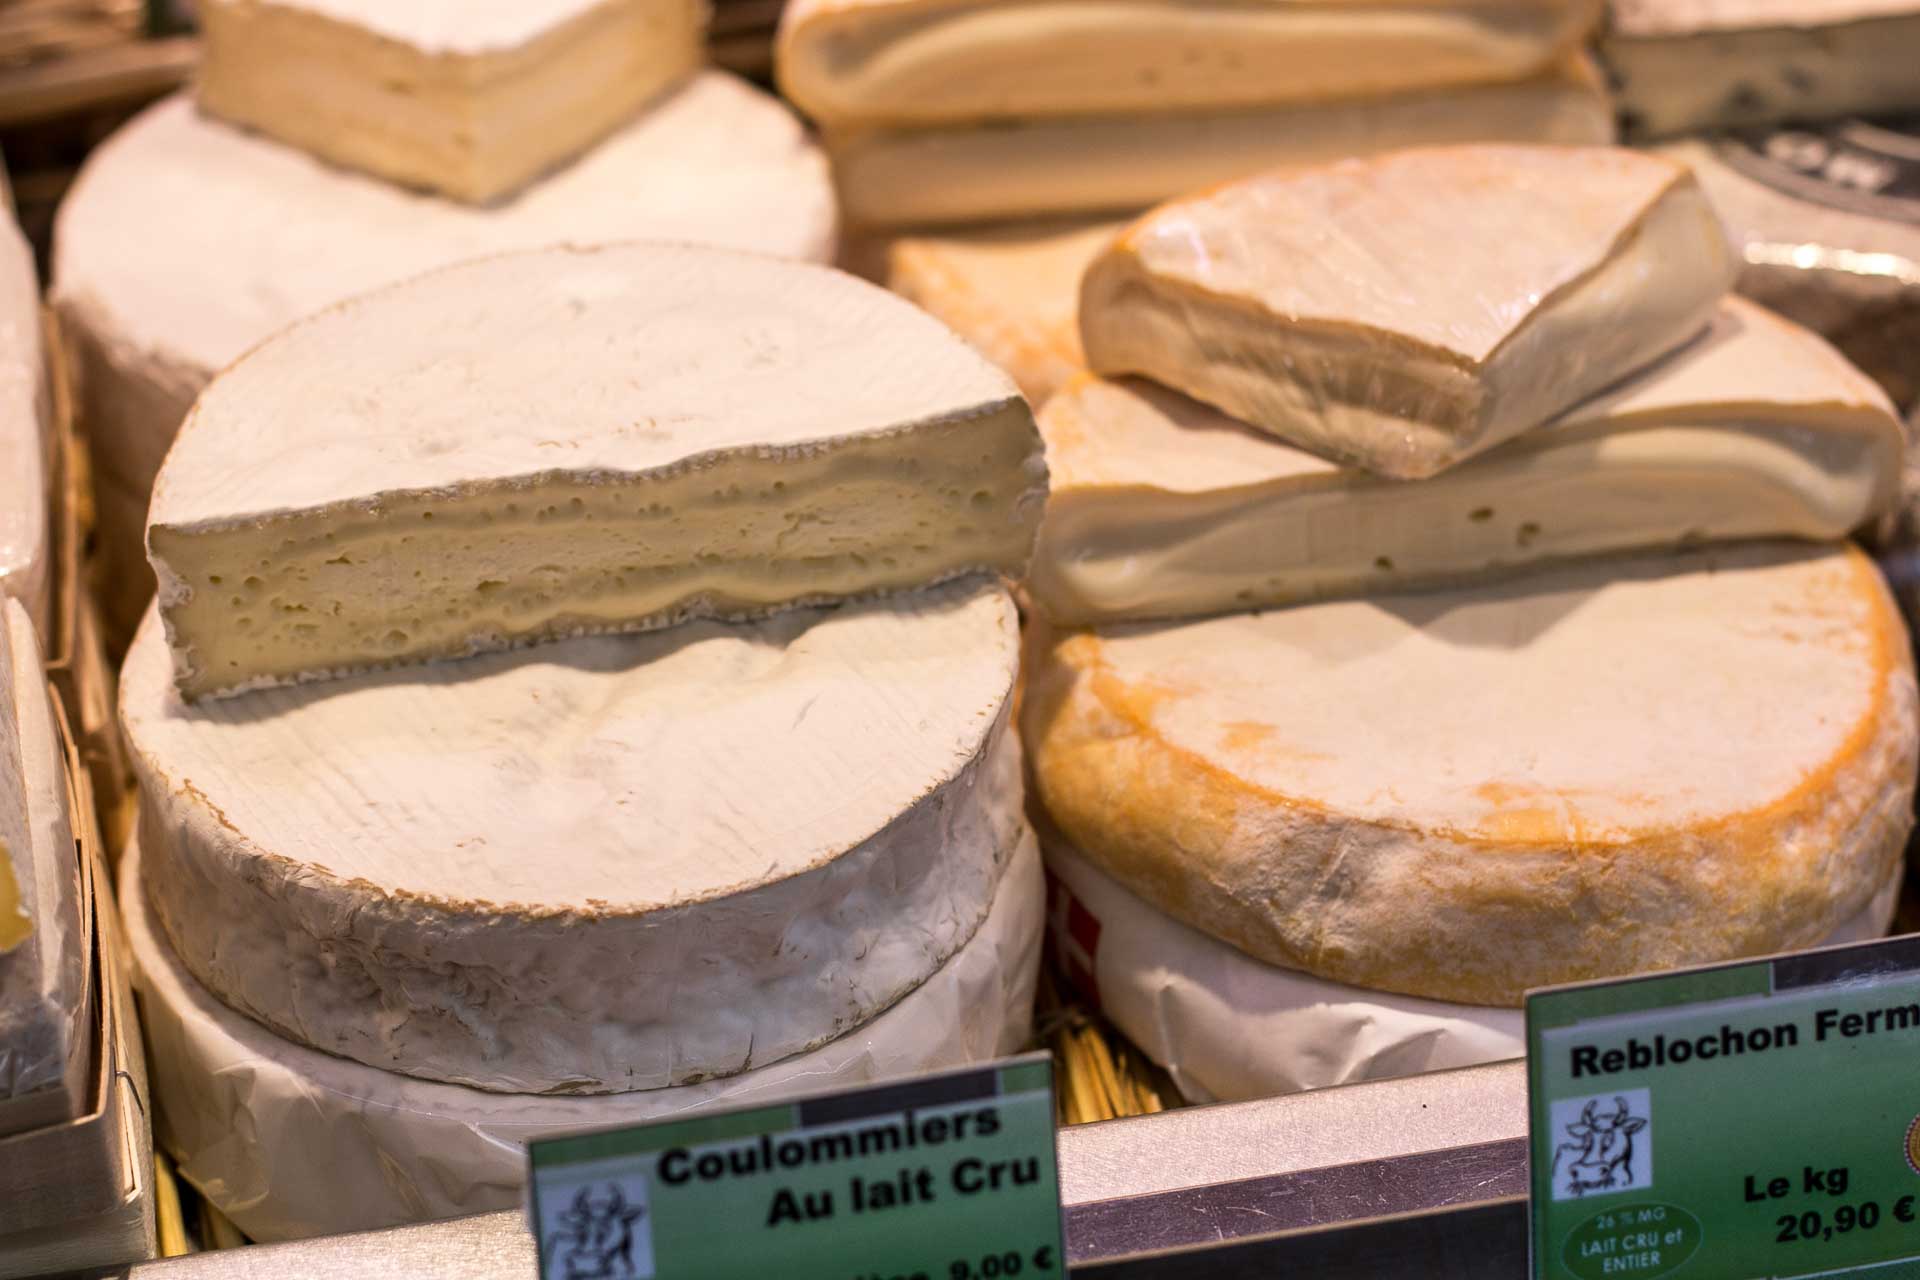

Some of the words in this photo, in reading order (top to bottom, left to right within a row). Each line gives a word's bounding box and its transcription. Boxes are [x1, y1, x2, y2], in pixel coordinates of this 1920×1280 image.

[1570, 1021, 1799, 1079] Reblochon
[656, 1106, 1001, 1186] Coulommiers
[765, 1188, 834, 1228] Au
[850, 1168, 934, 1214] lait
[951, 1155, 1040, 1195] Cru
[1743, 1174, 1791, 1203] Le
[1803, 1166, 1849, 1196] kg
[1637, 1205, 1666, 1222] MG
[1775, 1201, 1880, 1243] 20,90
[1893, 1195, 1915, 1223] €
[1033, 1245, 1053, 1270] €
[1580, 1236, 1616, 1257] LAIT
[1621, 1231, 1659, 1251] CRU
[1664, 1227, 1683, 1246] et
[1602, 1250, 1661, 1274] ENTIER
